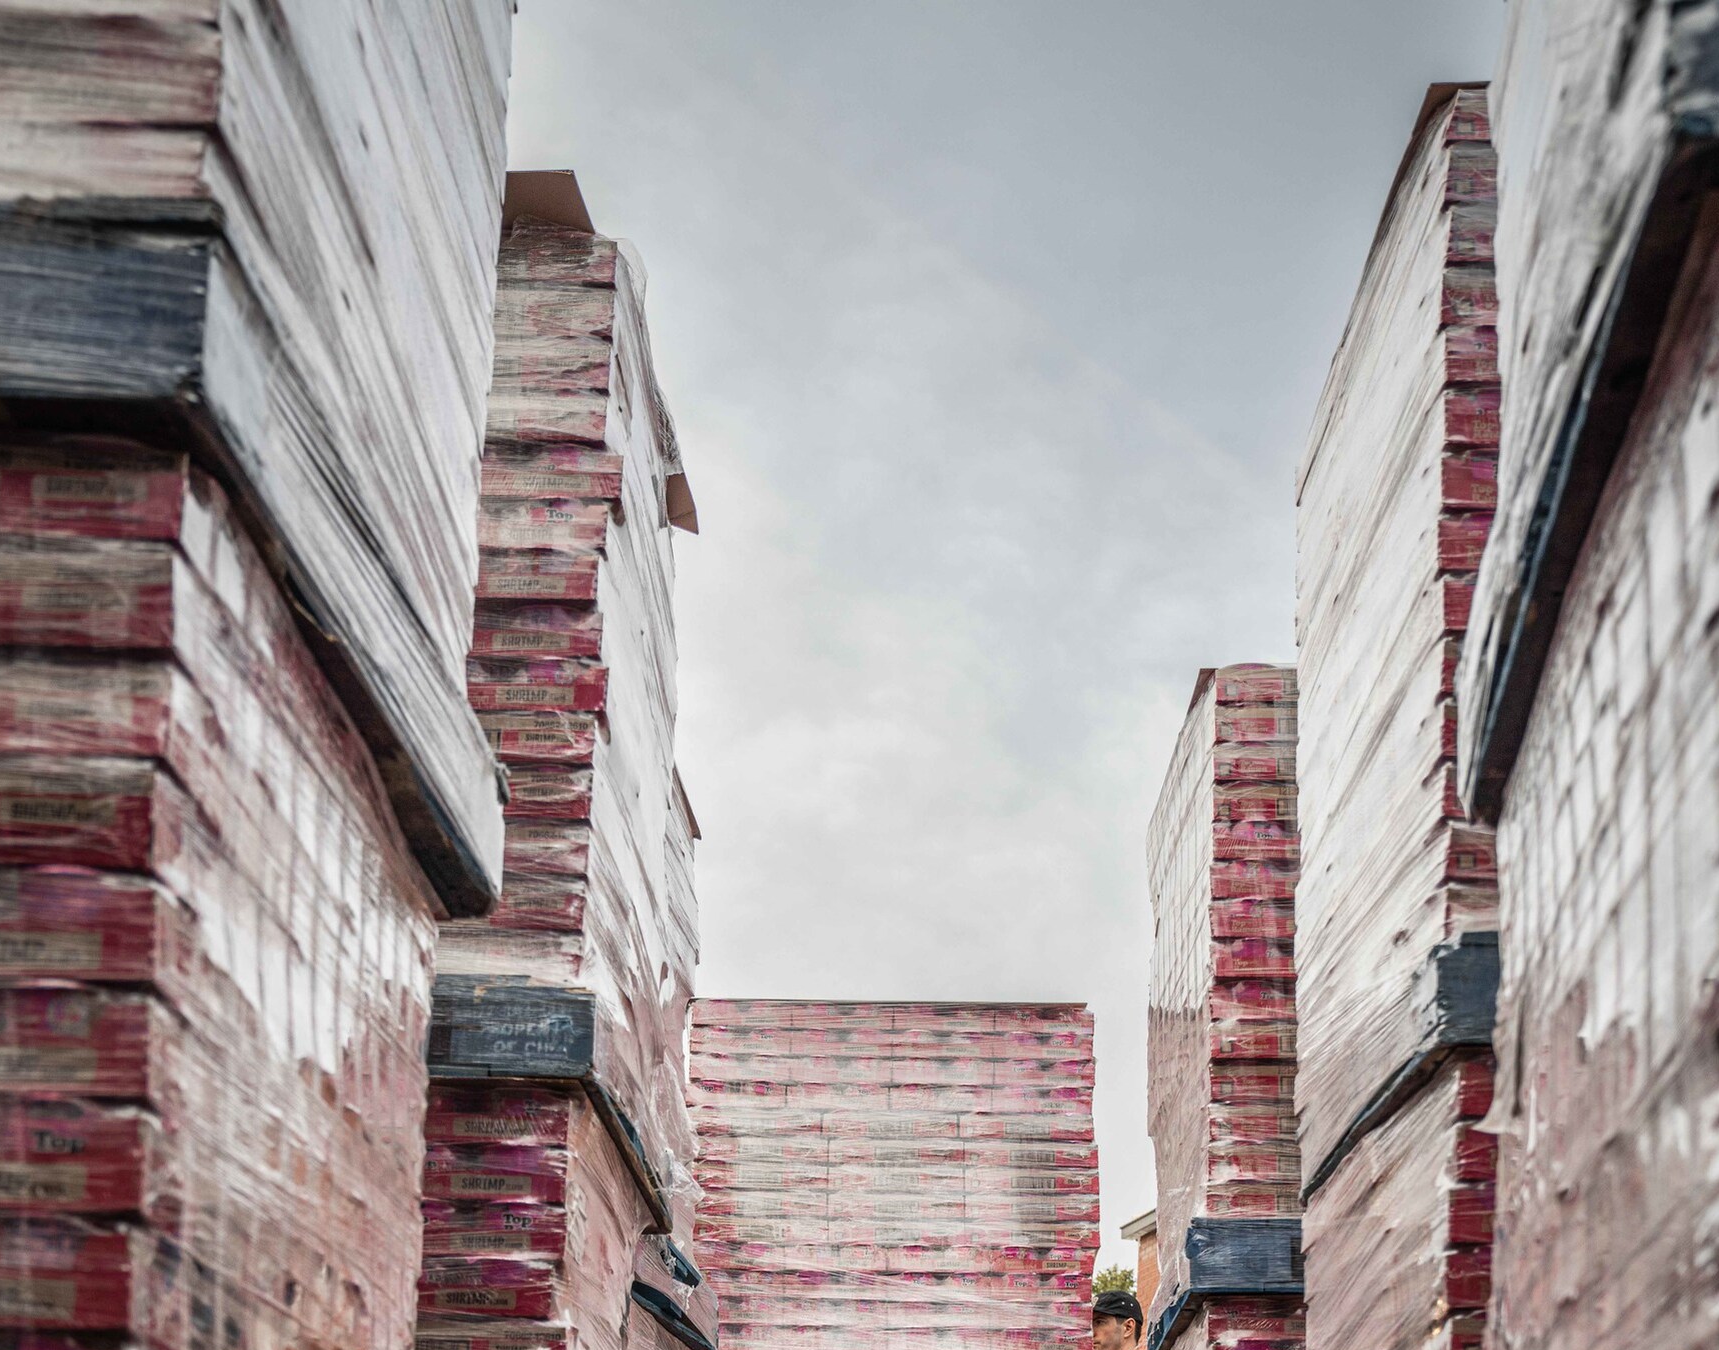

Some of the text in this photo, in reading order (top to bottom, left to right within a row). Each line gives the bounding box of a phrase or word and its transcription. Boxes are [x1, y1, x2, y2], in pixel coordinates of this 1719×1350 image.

[1471, 483, 1494, 494] Top
[546, 509, 574, 521] Top
[502, 635, 542, 646] SHRIMP
[506, 689, 547, 701] SHRIMP
[525, 733, 556, 742] SHRIMP
[33, 1131, 85, 1154] Top
[462, 1178, 505, 1190] SHRIMP
[503, 1213, 531, 1227] Top
[462, 1236, 505, 1247] SHRIMP
[446, 1292, 489, 1305] SHRIMP
